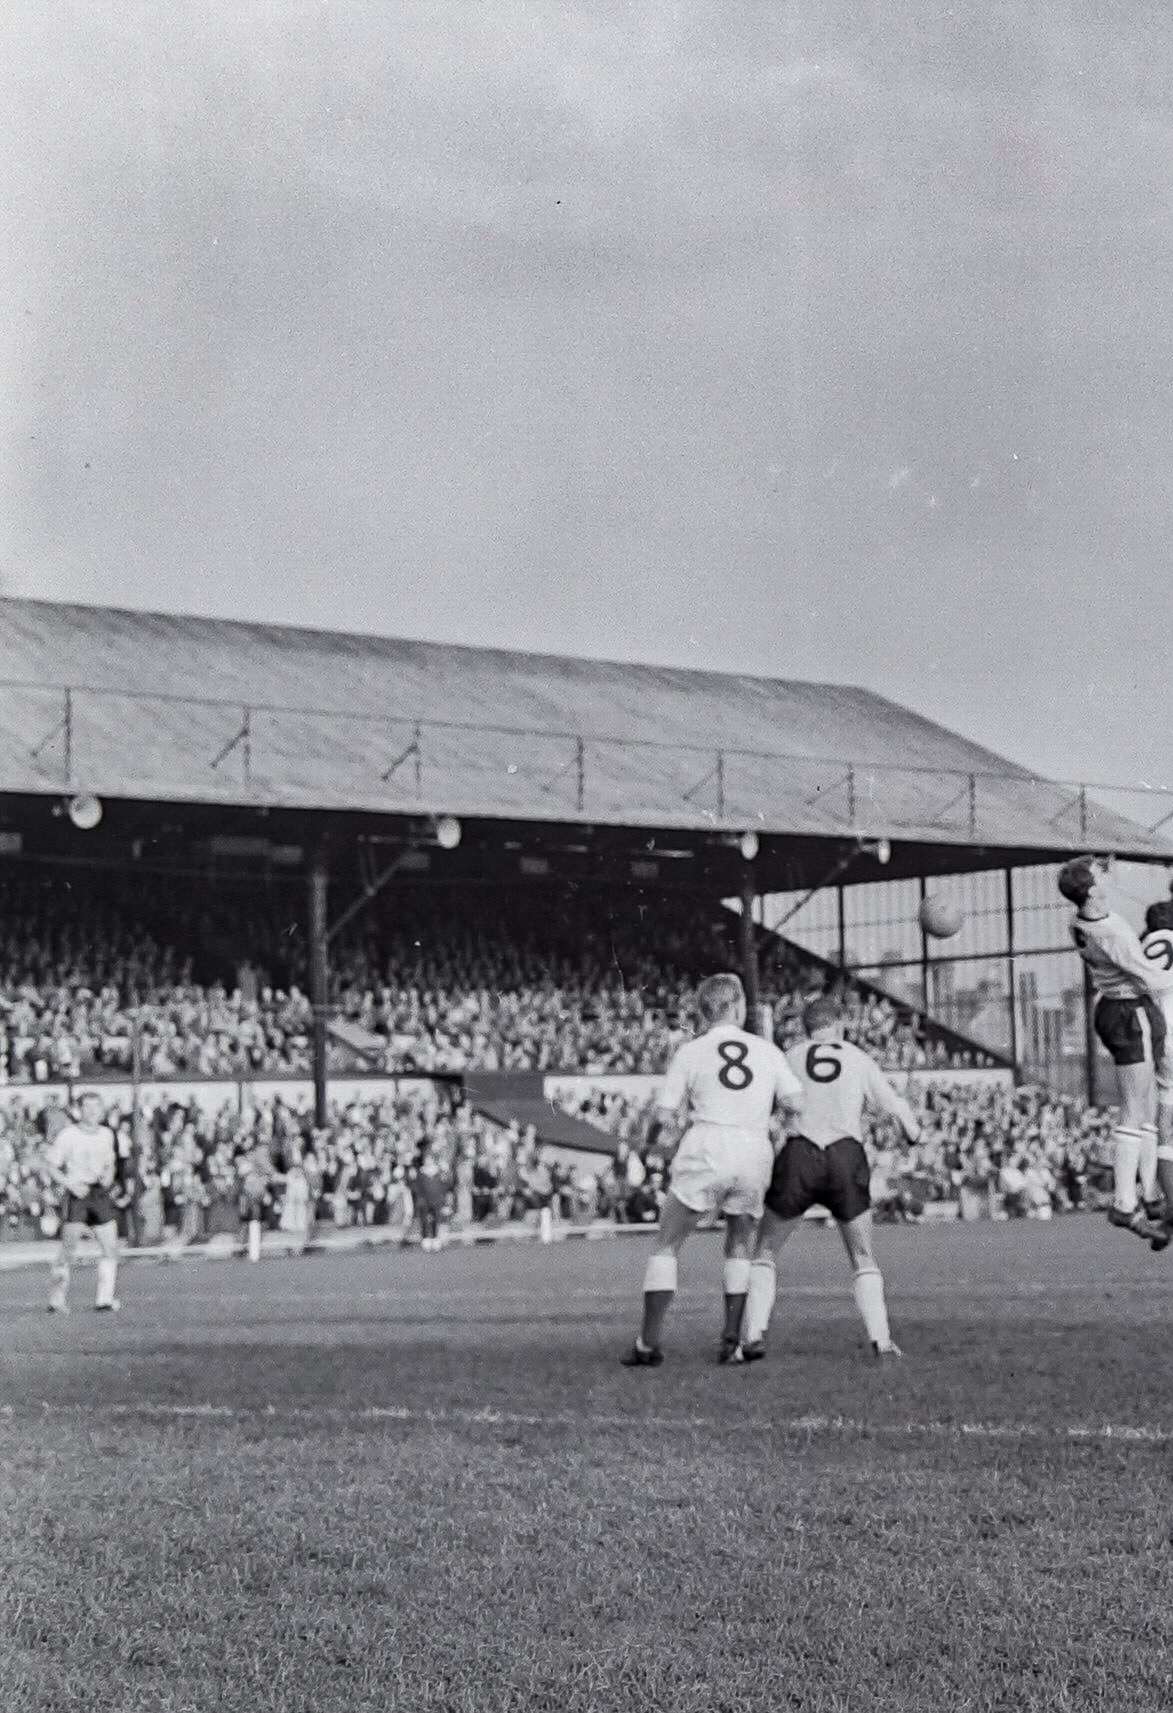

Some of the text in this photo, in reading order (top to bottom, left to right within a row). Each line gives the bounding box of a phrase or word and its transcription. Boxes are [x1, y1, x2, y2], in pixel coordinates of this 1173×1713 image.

[1144, 939, 1173, 971] 9
[718, 1041, 753, 1090] 8
[806, 1043, 842, 1083] 6
